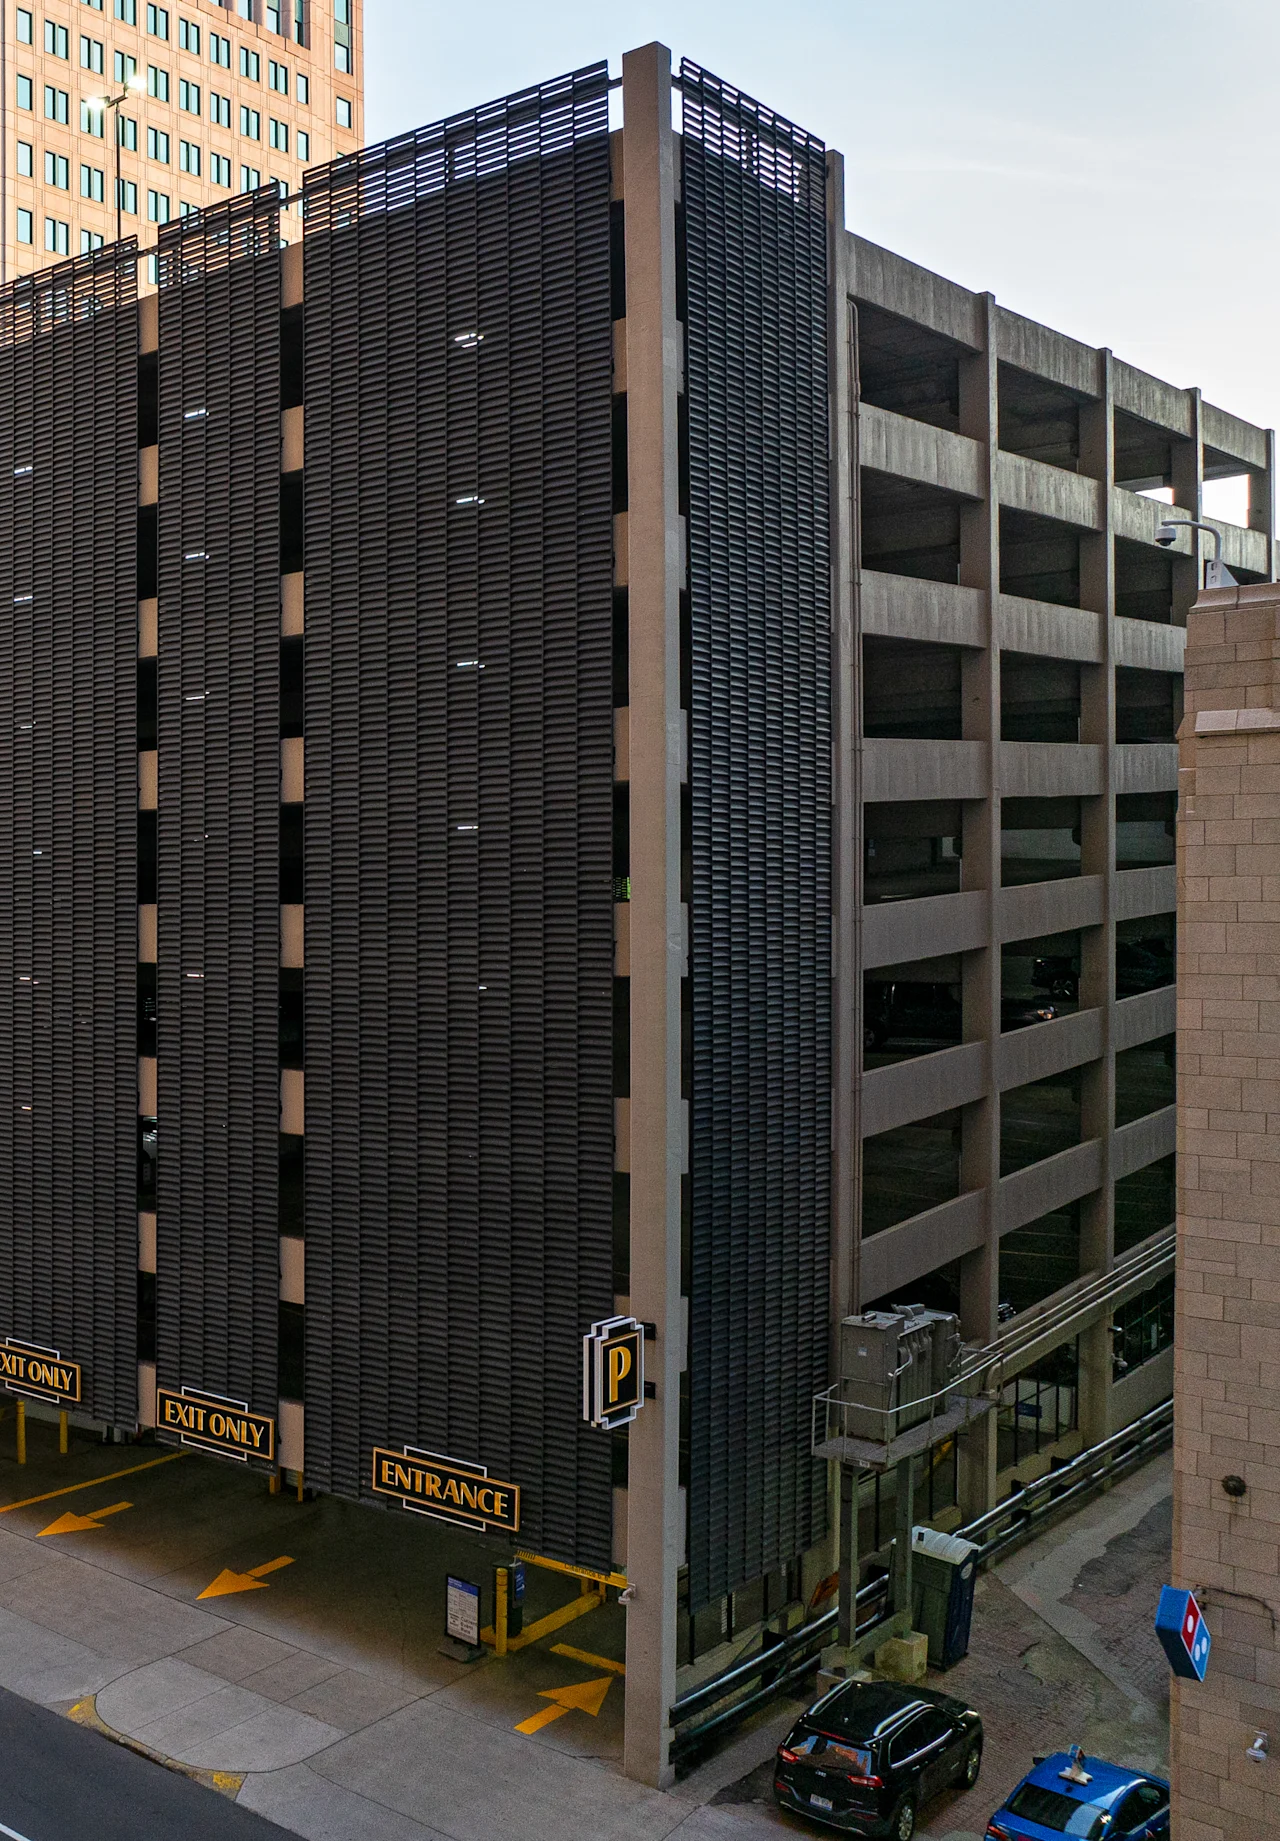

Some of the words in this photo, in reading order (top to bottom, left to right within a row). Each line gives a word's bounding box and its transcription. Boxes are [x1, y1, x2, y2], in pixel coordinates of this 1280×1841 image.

[28, 1361, 73, 1391] ONLY
[609, 1346, 631, 1403] P
[165, 1399, 207, 1431] EXIT
[209, 1413, 265, 1448] ONLY
[381, 1460, 509, 1518] ENTRANCE
